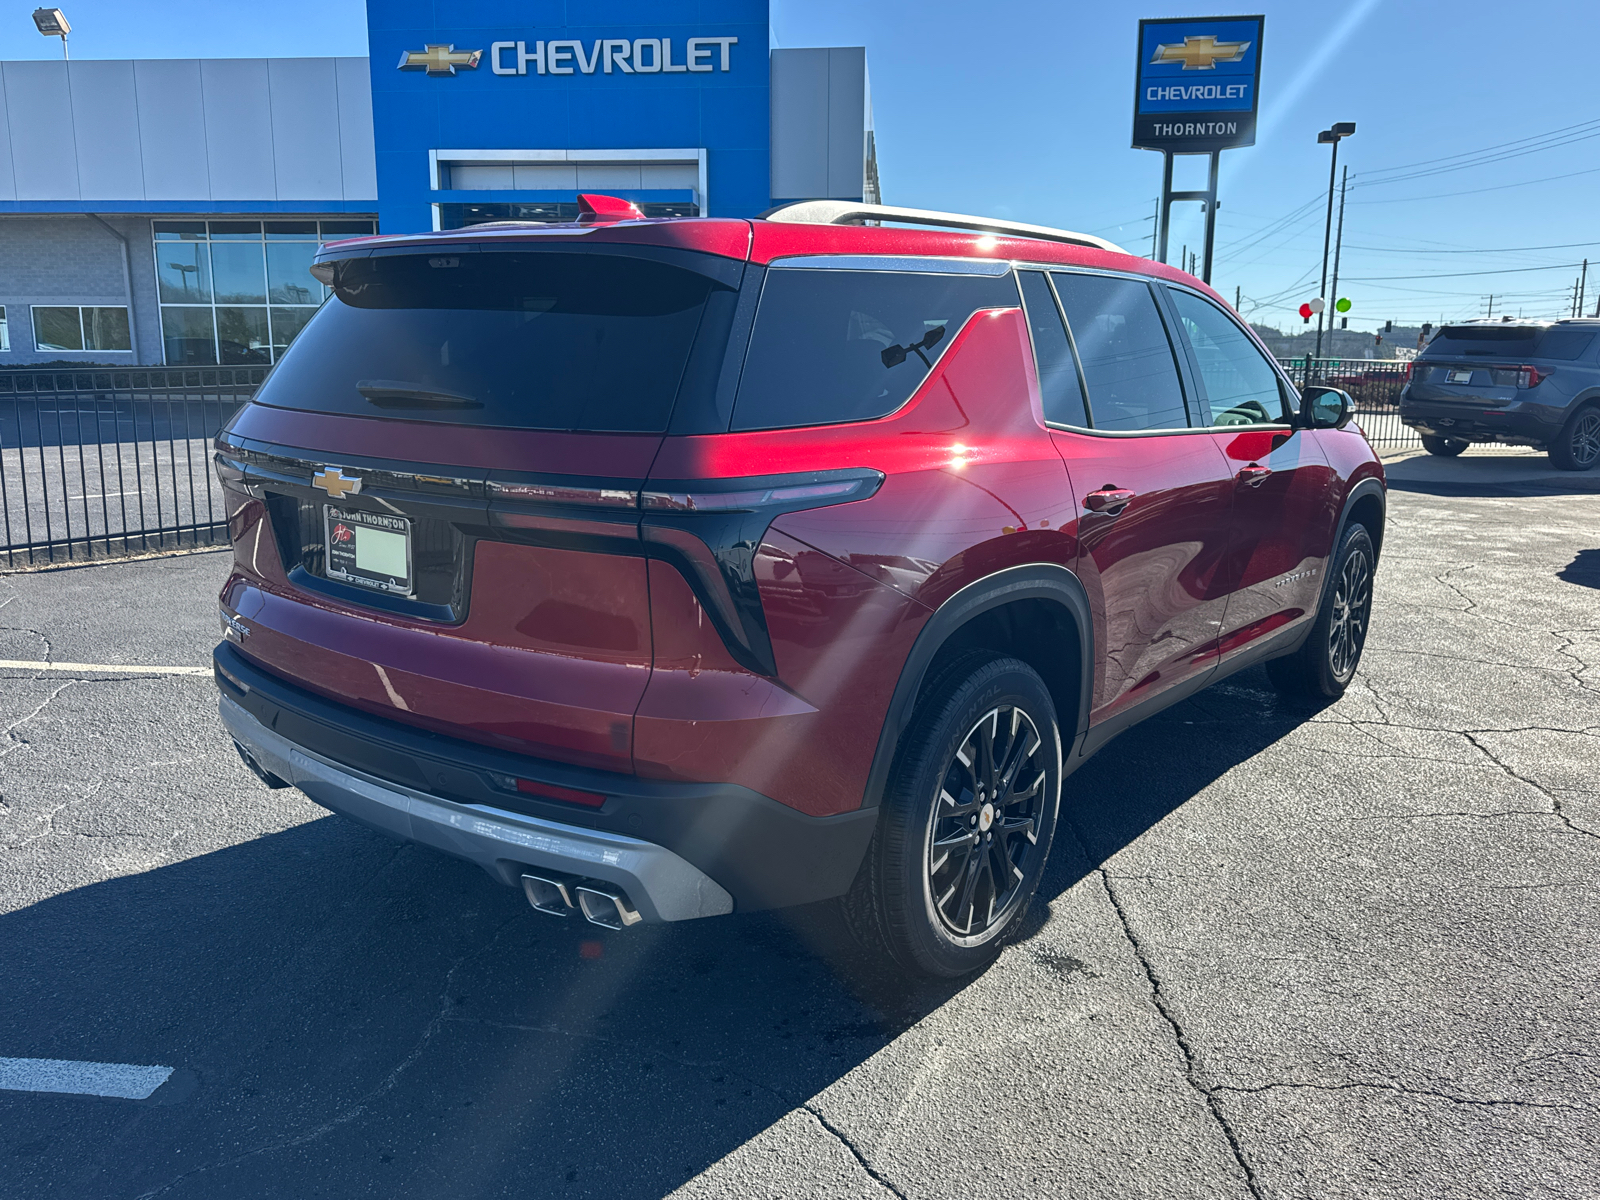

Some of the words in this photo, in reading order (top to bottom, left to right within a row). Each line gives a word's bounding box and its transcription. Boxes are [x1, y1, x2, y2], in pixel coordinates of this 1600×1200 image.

[491, 36, 738, 75] CHEVROLET
[1146, 84, 1248, 101] CHEVROLET
[1153, 121, 1237, 136] THORNTON
[363, 514, 405, 530] THORNTON
